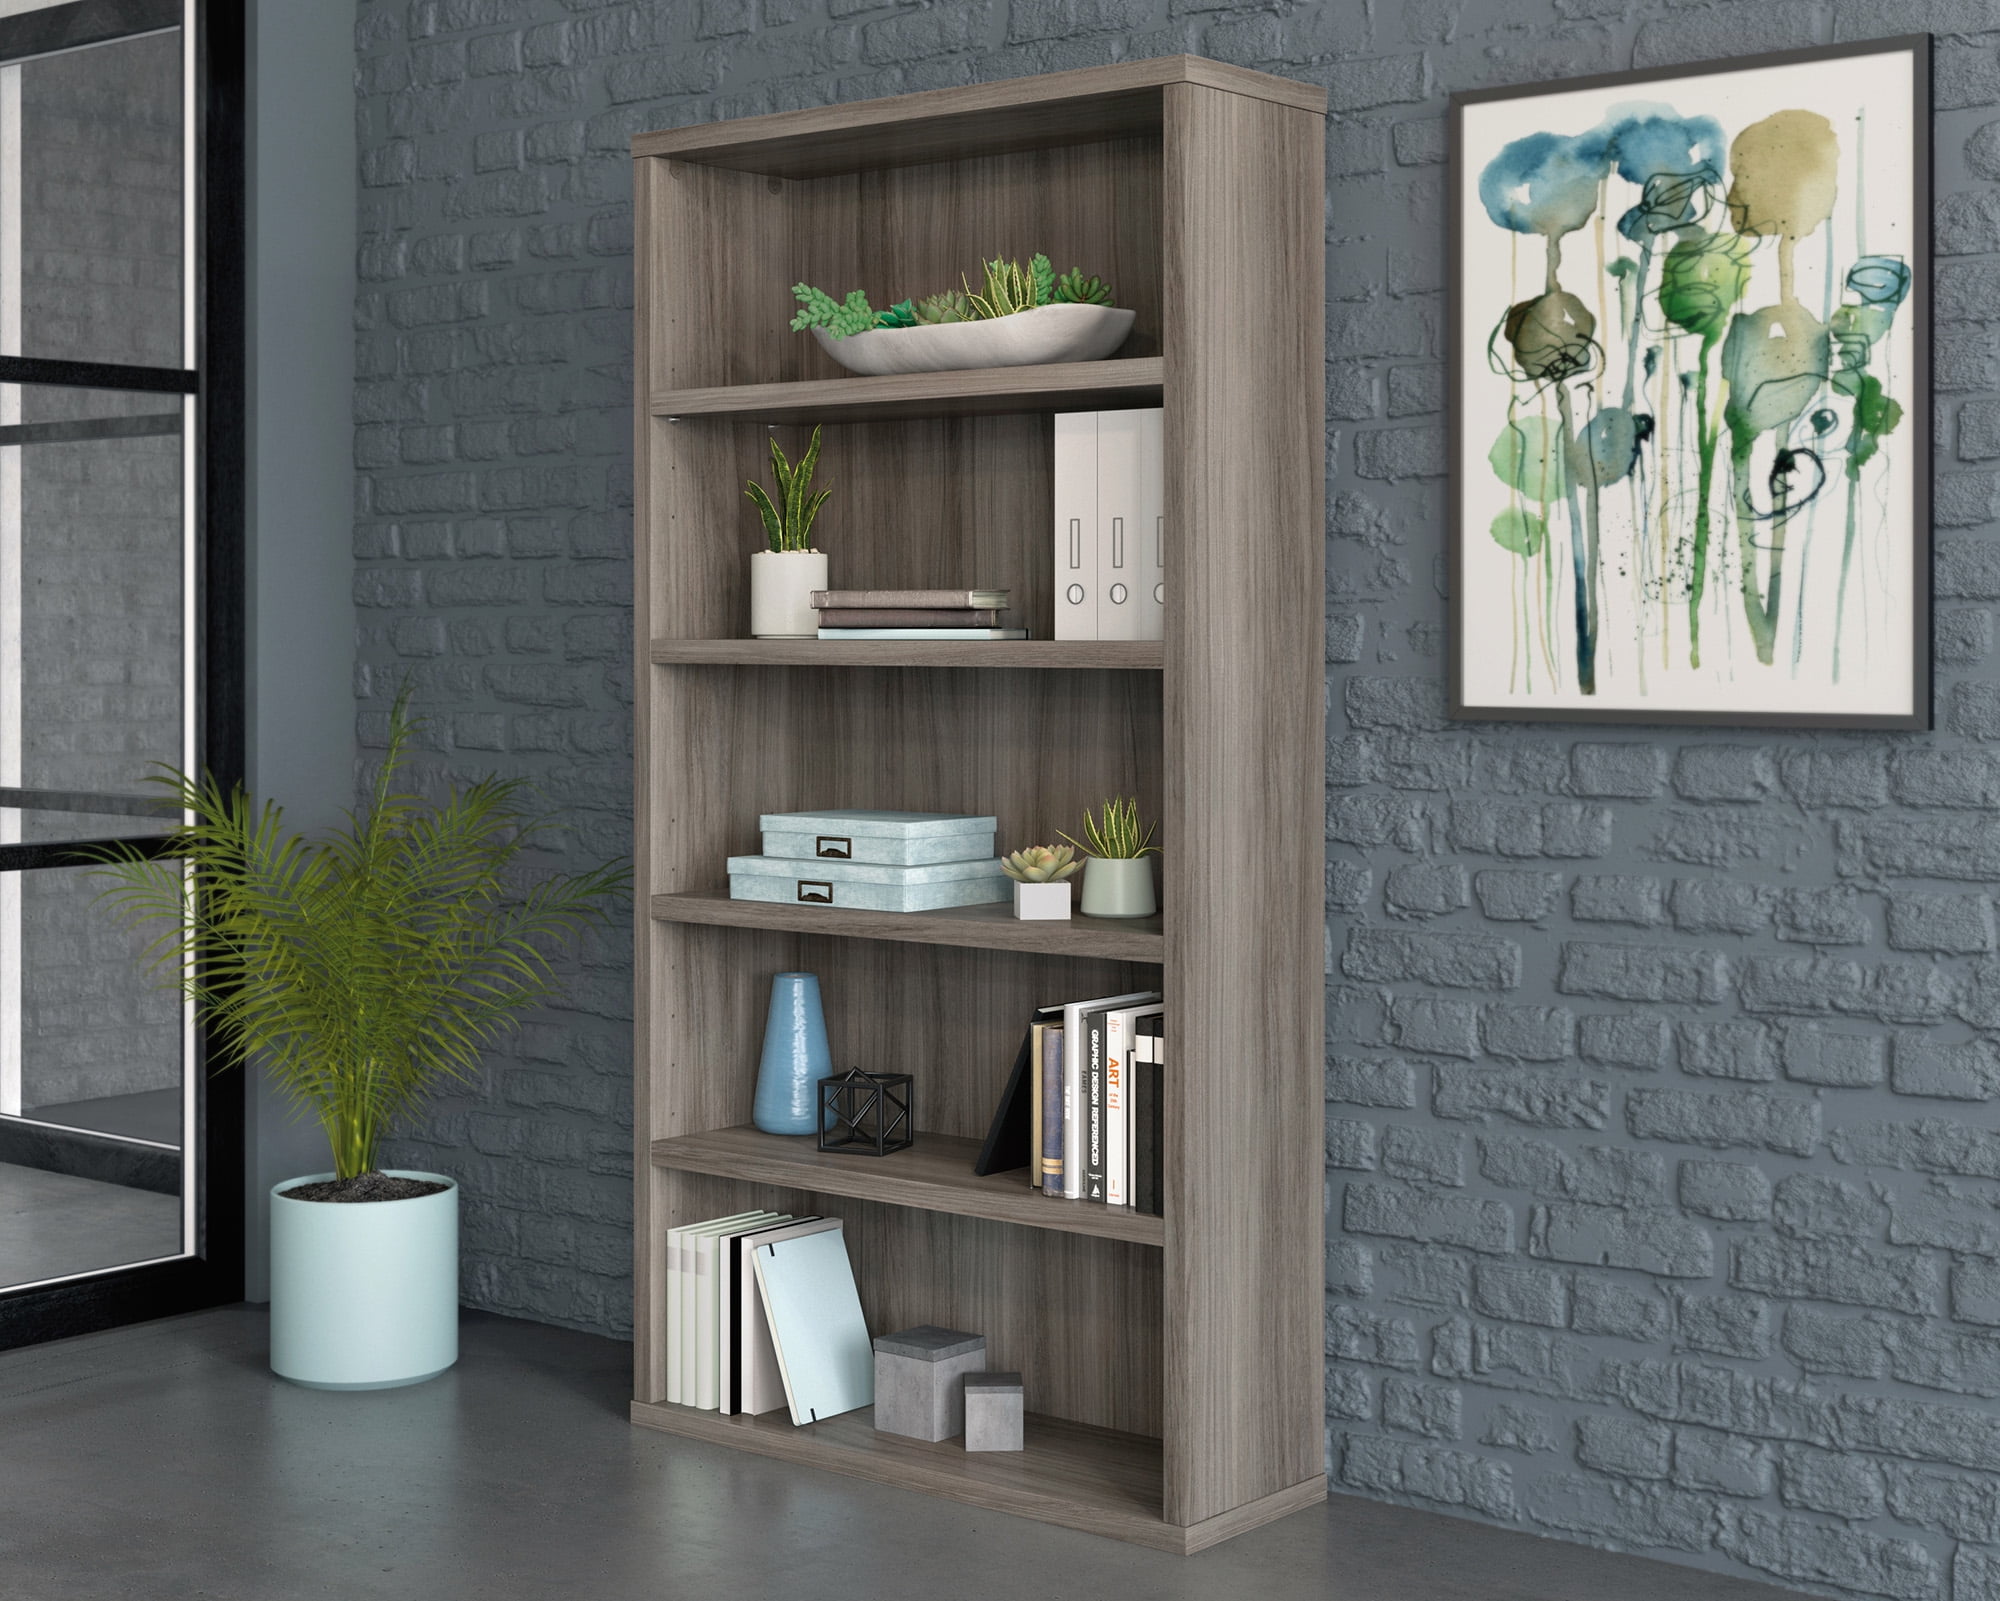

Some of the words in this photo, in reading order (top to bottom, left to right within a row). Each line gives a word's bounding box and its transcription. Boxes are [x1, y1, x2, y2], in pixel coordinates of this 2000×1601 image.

[1091, 1029, 1099, 1069] GRAPHIC
[1091, 1071, 1099, 1105] DESIGN
[1108, 1057, 1119, 1088] ART
[1091, 1106, 1099, 1166] REFERENCED
